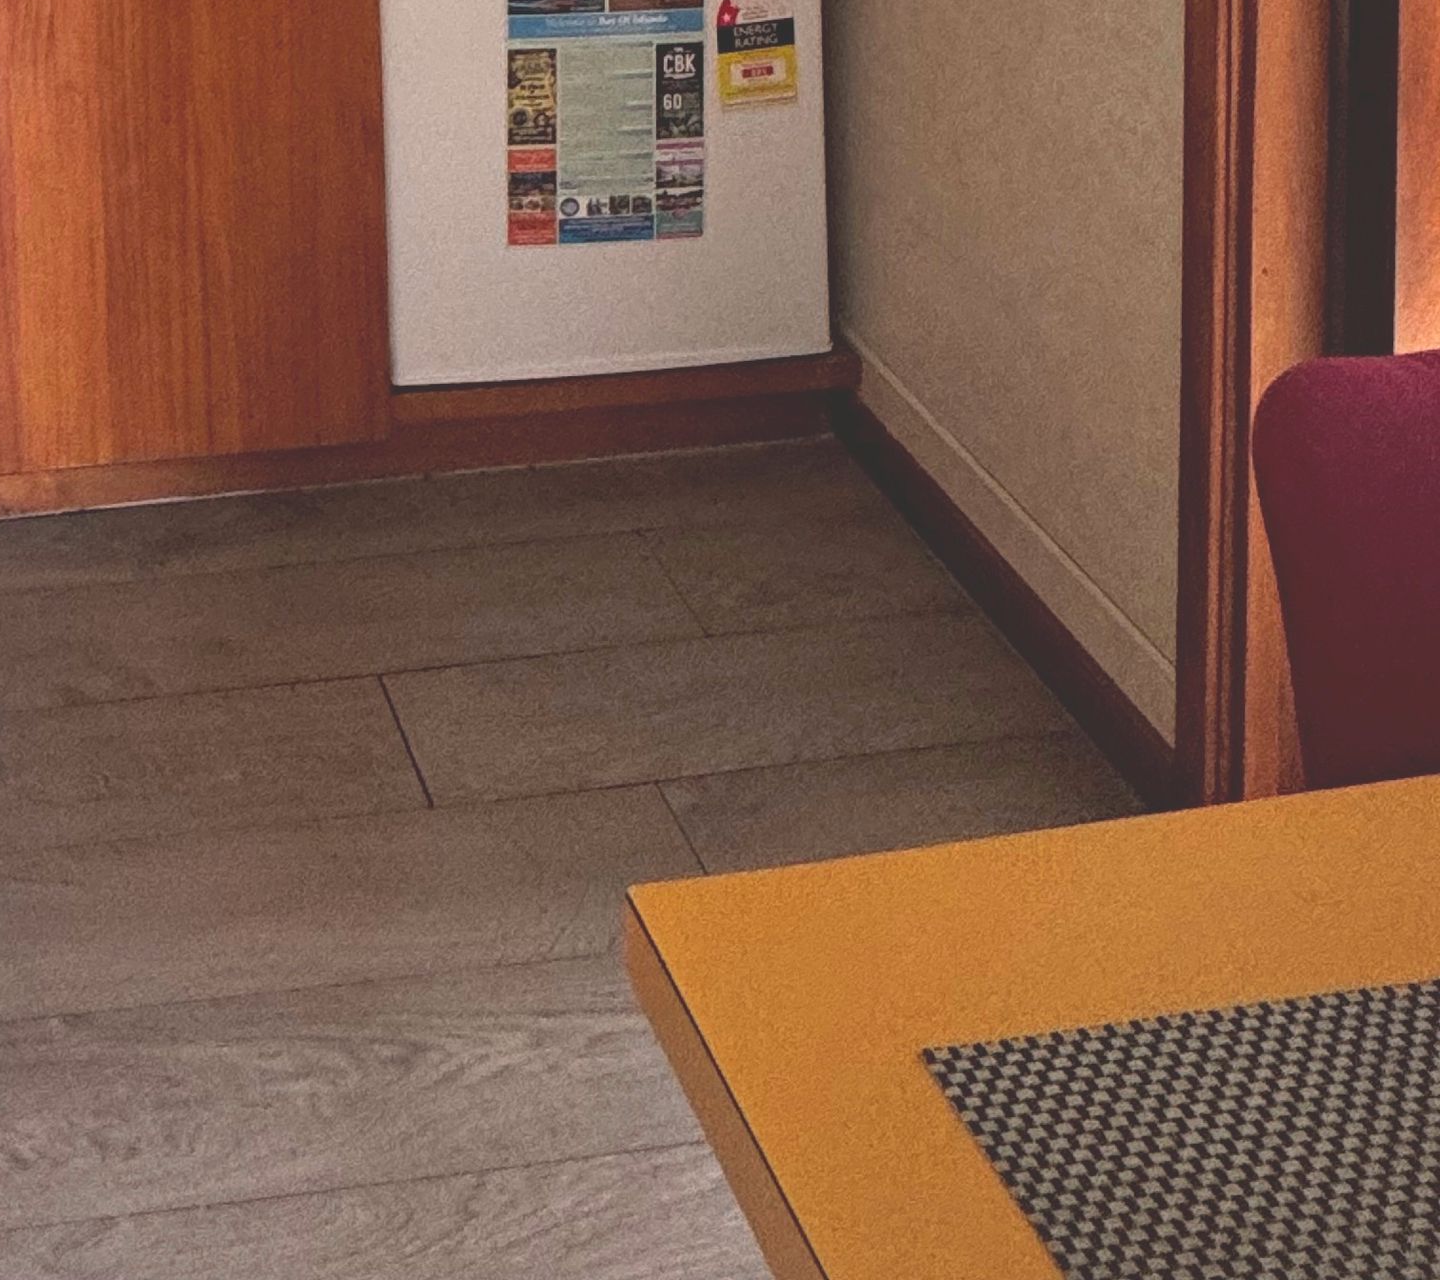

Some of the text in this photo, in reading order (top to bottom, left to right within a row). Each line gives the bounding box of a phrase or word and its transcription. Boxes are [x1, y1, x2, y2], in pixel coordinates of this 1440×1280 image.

[733, 23, 778, 37] ENERGY
[734, 33, 779, 49] RATING
[663, 53, 696, 73] CBK
